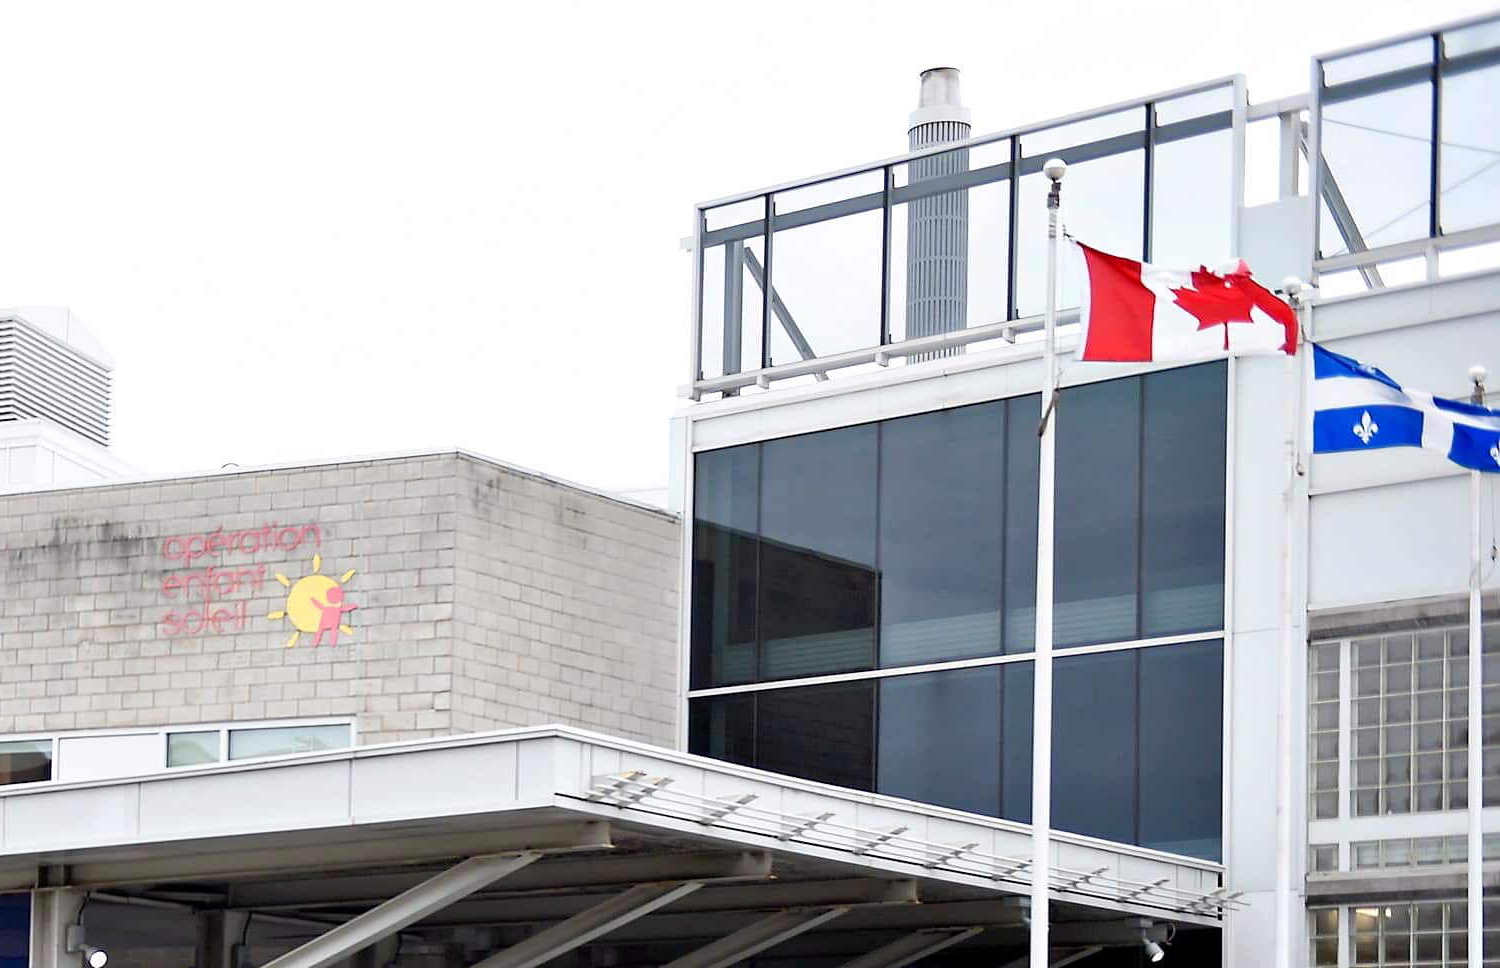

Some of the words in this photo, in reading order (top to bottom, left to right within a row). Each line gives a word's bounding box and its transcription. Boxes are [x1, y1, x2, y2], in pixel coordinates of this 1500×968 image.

[162, 523, 320, 565] opération
[162, 562, 266, 608] enfant
[162, 601, 247, 637] soleil
